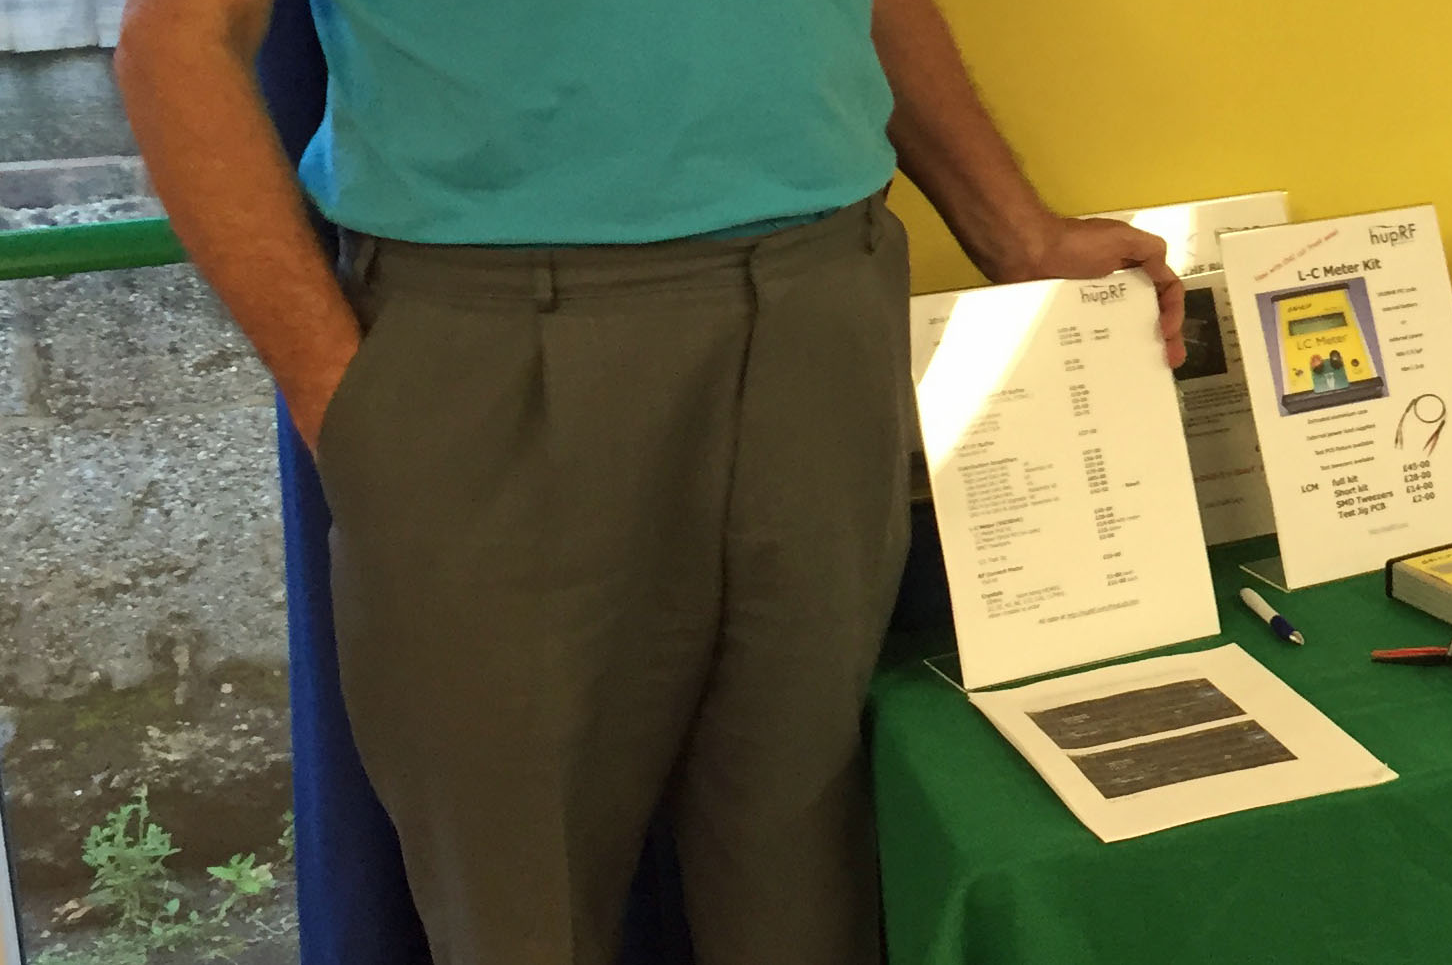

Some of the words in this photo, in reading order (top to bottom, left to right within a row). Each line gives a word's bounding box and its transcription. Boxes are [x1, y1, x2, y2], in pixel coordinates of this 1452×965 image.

[1369, 223, 1416, 247] hupRF
[1297, 267, 1320, 282] L-C
[1323, 261, 1360, 278] Meter
[1362, 257, 1382, 272] Kit
[1079, 283, 1127, 305] hupRF
[1296, 337, 1312, 350] LC
[1316, 333, 1348, 347] Meter
[1334, 487, 1357, 498] Short
[1356, 490, 1394, 505] Tweezers
[1338, 508, 1356, 519] Test
